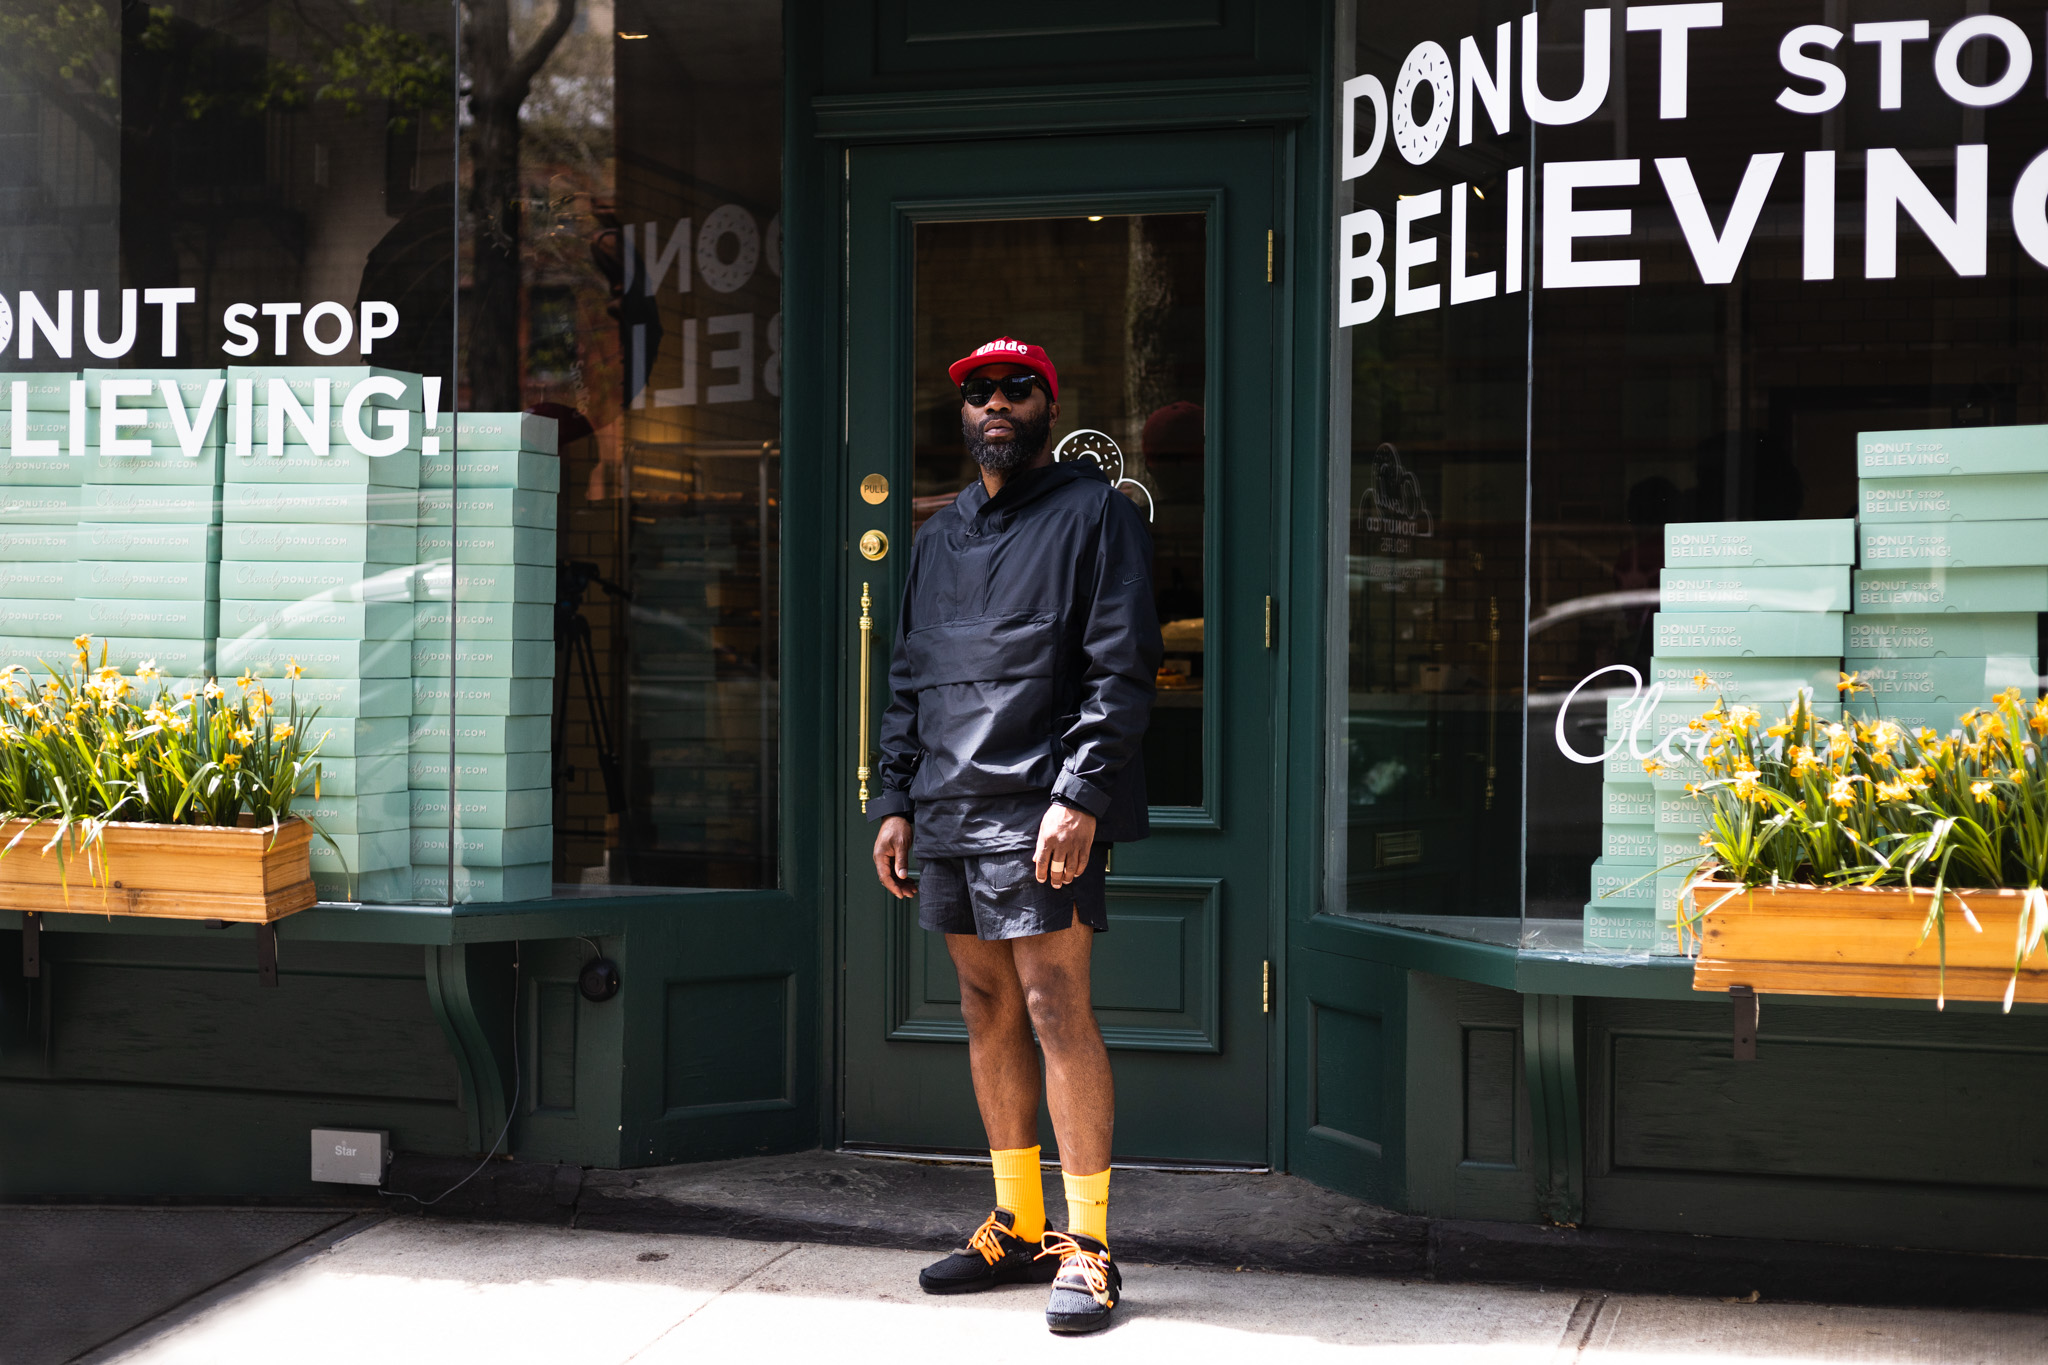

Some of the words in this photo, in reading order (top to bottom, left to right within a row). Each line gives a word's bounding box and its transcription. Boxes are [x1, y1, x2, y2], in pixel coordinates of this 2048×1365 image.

[1342, 2, 1723, 182] DONUT
[1776, 14, 2048, 114] STO
[0, 287, 196, 359] NUT
[222, 301, 399, 357] STOP
[10, 376, 442, 457] LIEVING!
[1864, 443, 1912, 454] DONUT
[1916, 444, 1943, 452] STOP
[1864, 453, 1950, 467] BELIEVING!
[864, 484, 886, 494] PULL
[1866, 490, 1914, 500] DONUT
[1917, 491, 1944, 499] STOP
[1866, 501, 1951, 513] BELIEVING!
[1671, 534, 1717, 545] DONUT
[1721, 536, 1747, 544] STOP
[1867, 535, 1915, 546] DONUT
[1918, 537, 1945, 545] STOP
[1671, 545, 1753, 557] BELIEVING!
[1867, 546, 1951, 559] BELIEVING!
[1666, 580, 1713, 590] DONUT
[1716, 581, 1742, 589] STOP
[1860, 581, 1908, 591] DONUT
[1911, 582, 1938, 590] STOP
[1861, 591, 1944, 604] BELIEVING!
[1660, 624, 1707, 634] DONUT
[1710, 626, 1736, 634] STOP
[1850, 625, 1898, 635] DONUT
[1901, 627, 1928, 635] STOP
[1660, 636, 1742, 647] BELIEVING!
[1850, 637, 1934, 648] BELIEVING!
[1858, 670, 1898, 680] ONUT
[1902, 672, 1928, 680] STOP
[1609, 793, 1652, 802] DONUT
[1608, 835, 1652, 844] DONUT
[1590, 917, 1633, 927] DONUT
[335, 1145, 357, 1157] Star
